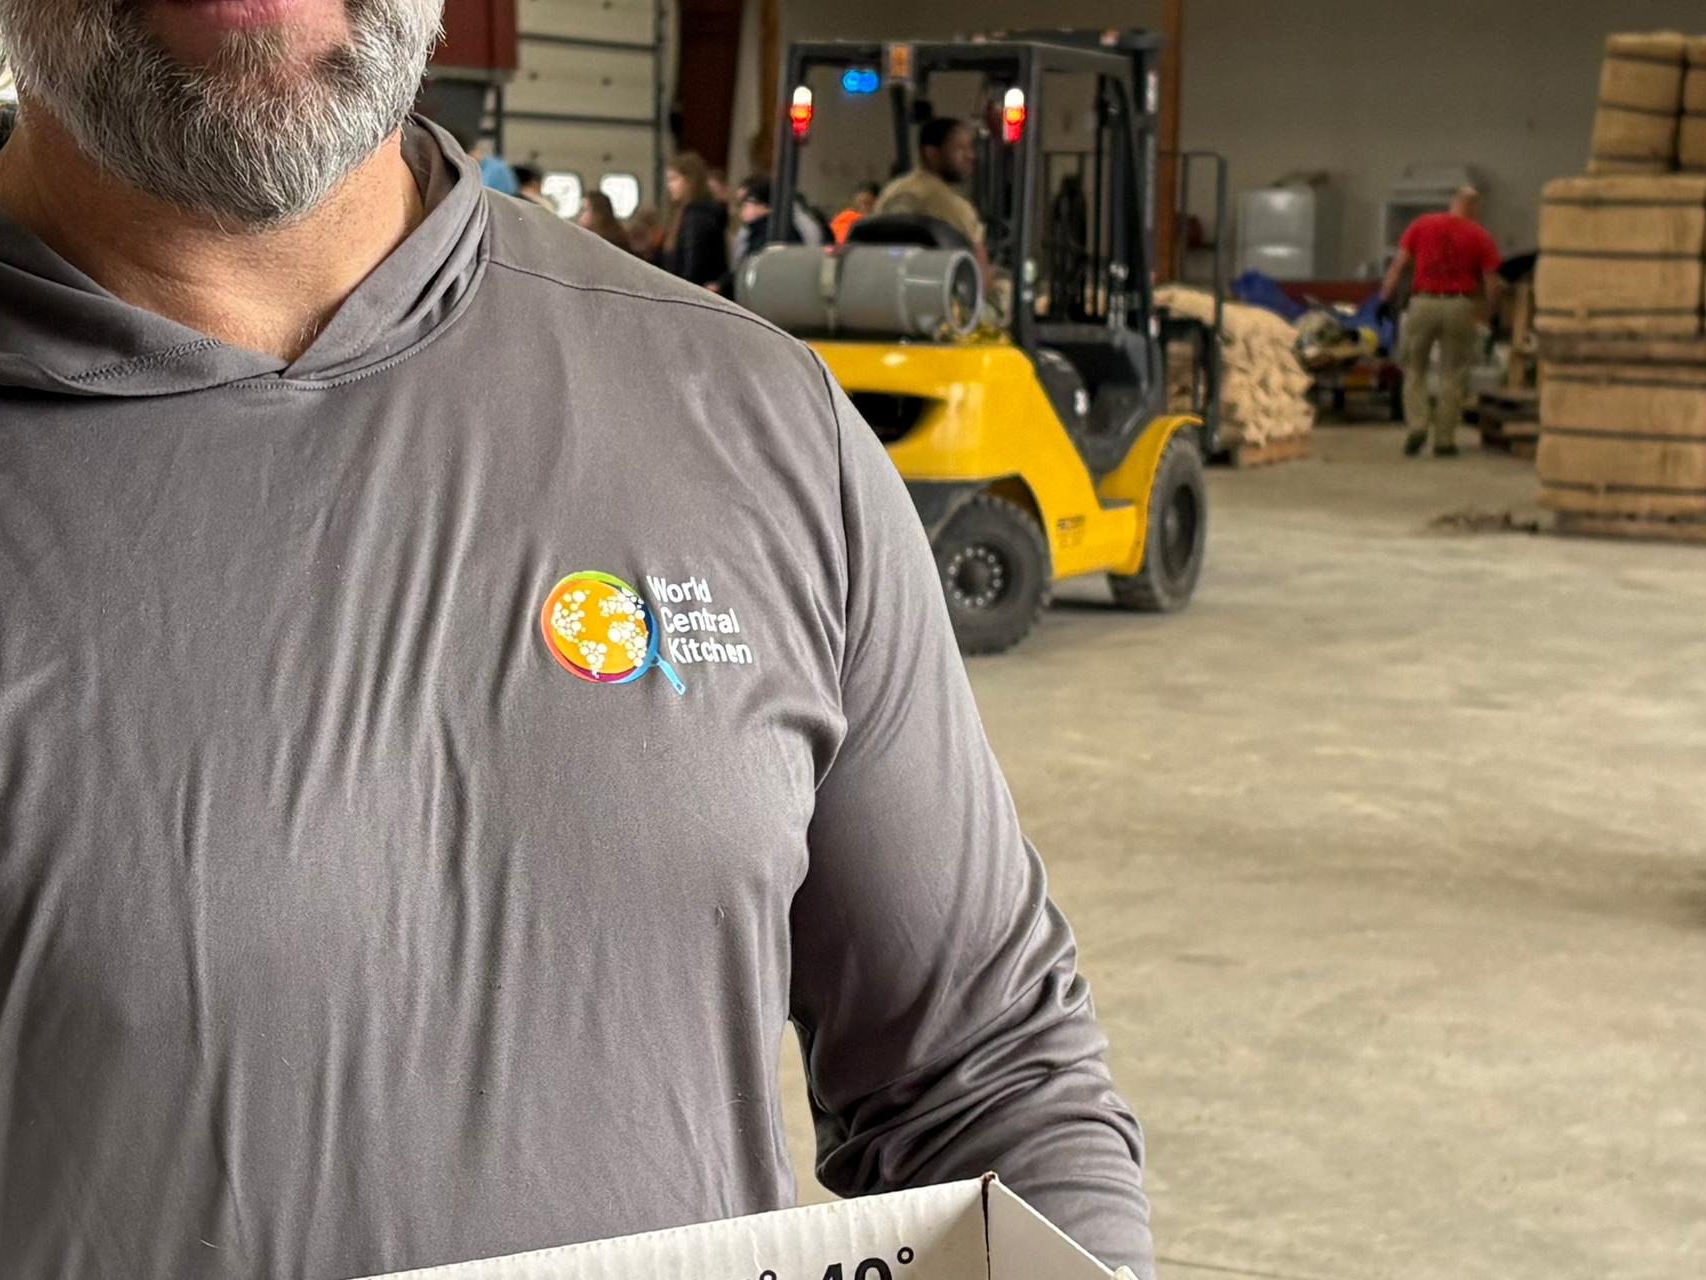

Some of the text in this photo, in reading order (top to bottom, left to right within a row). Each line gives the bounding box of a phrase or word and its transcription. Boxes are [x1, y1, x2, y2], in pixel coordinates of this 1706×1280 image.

[645, 575, 712, 604] World
[660, 607, 741, 635] Central
[668, 637, 753, 665] Kitchen
